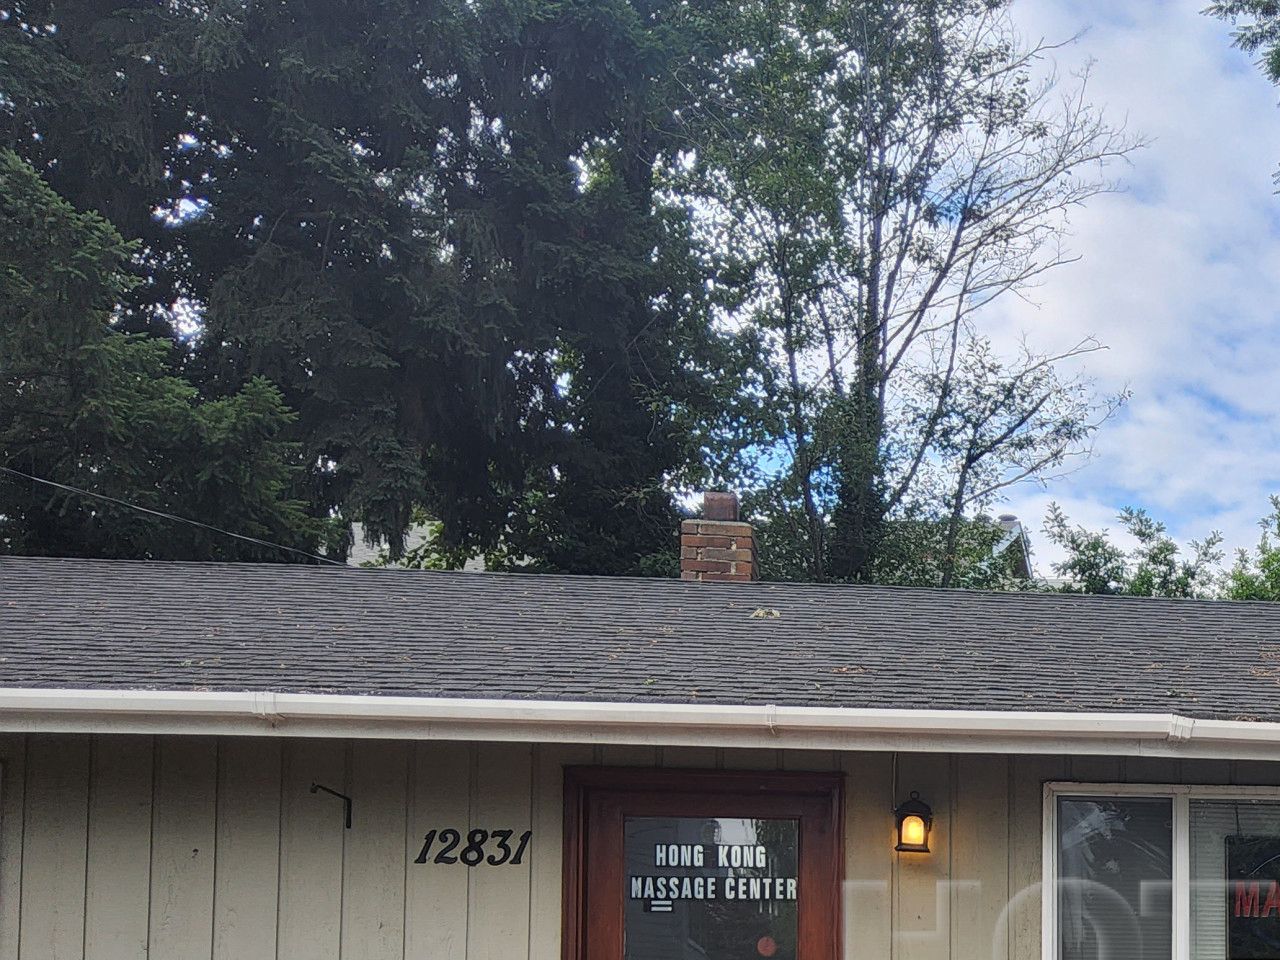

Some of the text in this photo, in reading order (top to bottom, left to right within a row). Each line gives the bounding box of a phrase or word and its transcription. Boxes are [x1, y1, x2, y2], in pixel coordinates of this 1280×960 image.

[414, 828, 532, 867] 12831
[655, 844, 767, 868] HONG KONG
[631, 876, 797, 900] MASSAGE CENTER
